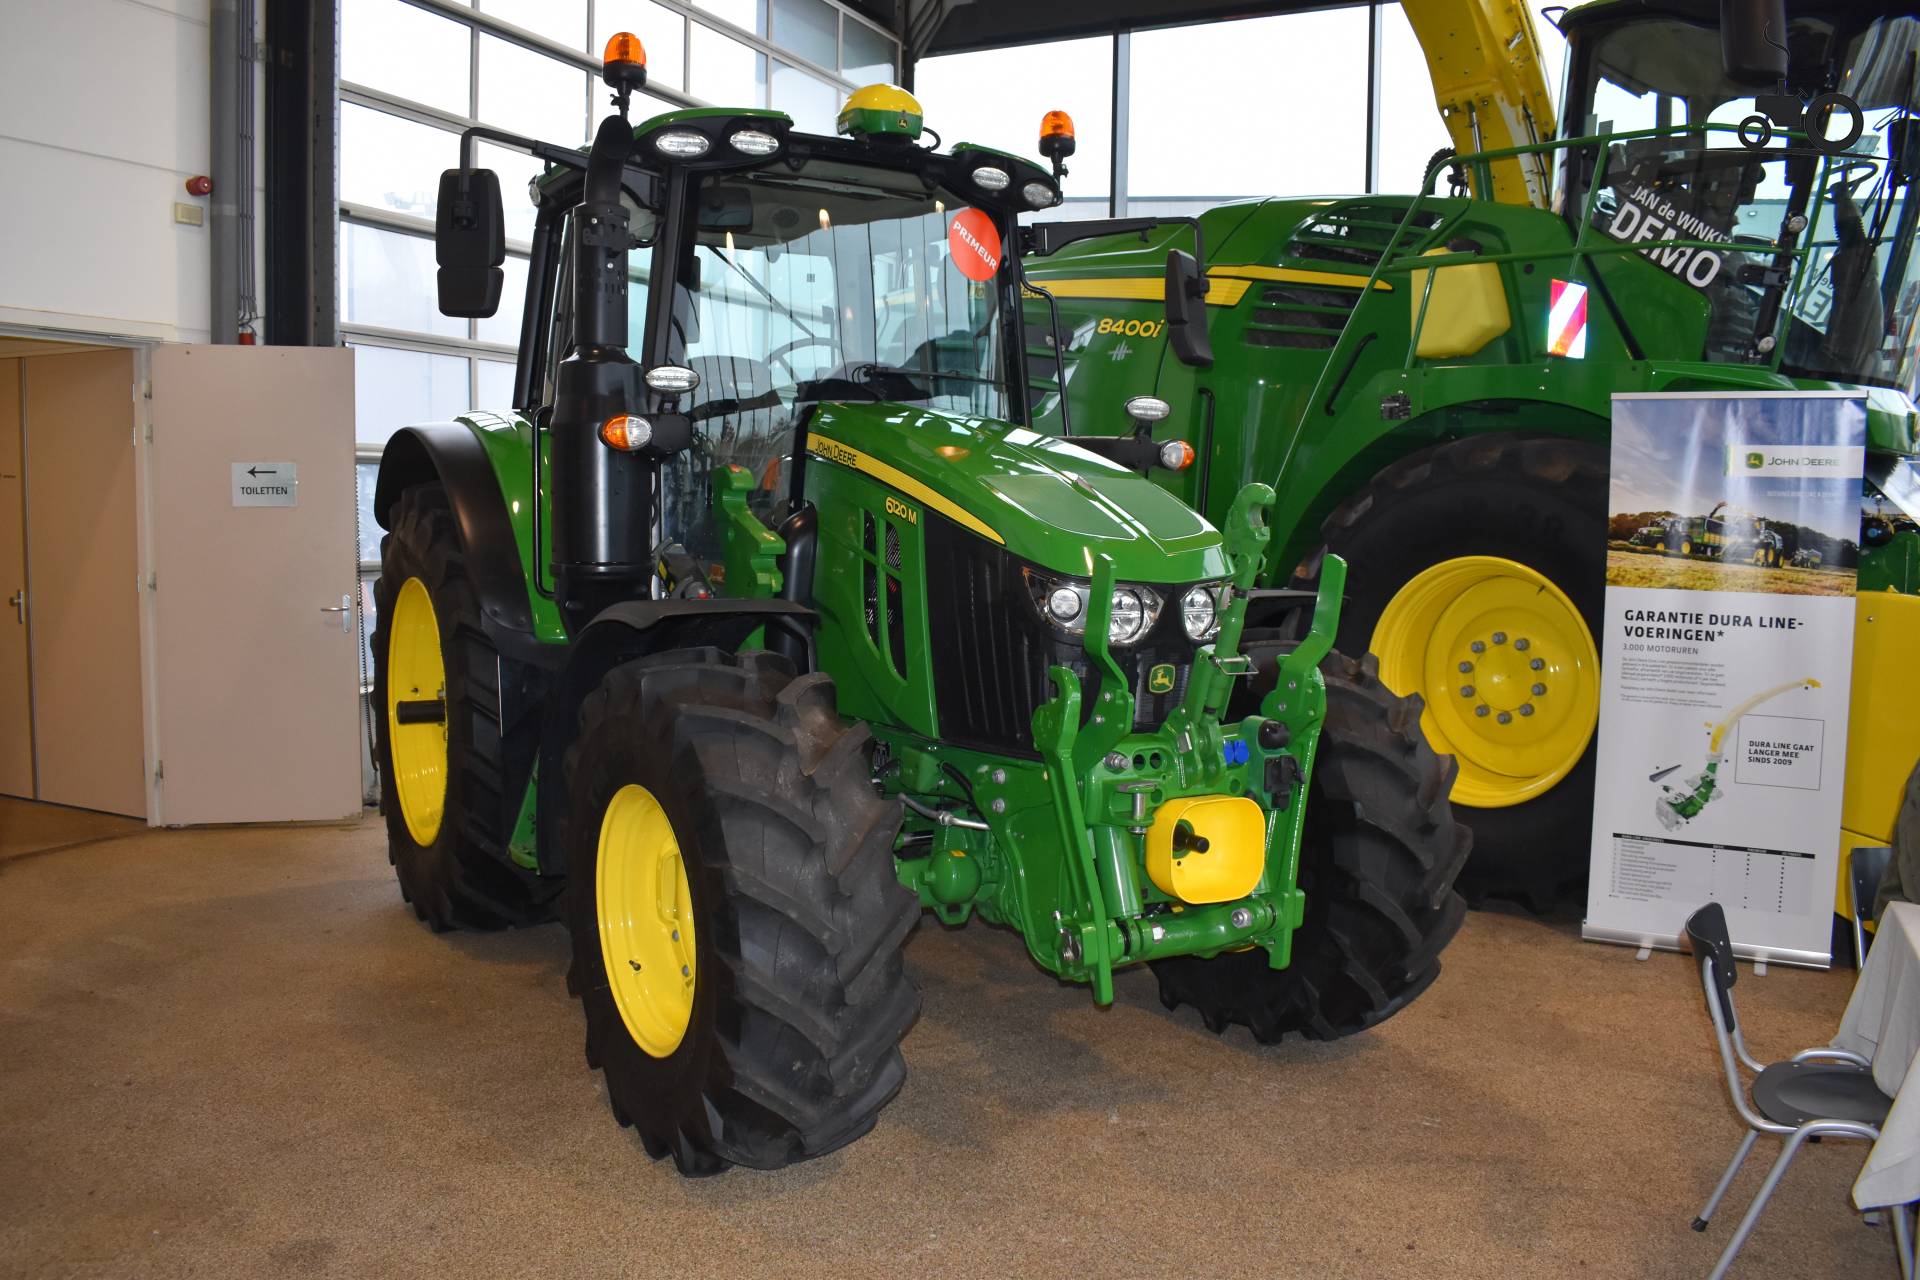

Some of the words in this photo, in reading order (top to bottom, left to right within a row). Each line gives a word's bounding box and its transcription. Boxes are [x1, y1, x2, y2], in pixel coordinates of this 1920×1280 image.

[1630, 186, 1660, 211] JAN
[1658, 202, 1676, 221] de
[953, 220, 997, 271] PRIMEUR
[1609, 202, 1721, 288] DEMO
[1097, 318, 1165, 338] 8400i
[815, 440, 832, 456] JOHN
[833, 445, 857, 466] DEERE
[1768, 457, 1799, 466] JOHN
[1801, 457, 1840, 467] DEERE
[240, 486, 288, 495] TOILETTEN
[1624, 609, 1704, 625] GARANTIE
[1709, 614, 1753, 628] DURA
[1759, 616, 1804, 630] LINE-
[1623, 643, 1645, 652] 3.000
[1647, 644, 1699, 655] MOTORUREN
[1748, 748, 1780, 757] LANGER
[1749, 740, 1771, 748] DURA
[1793, 743, 1815, 752] GAAT
[1748, 756, 1771, 764] SINDS
[1773, 758, 1793, 766] 2009
